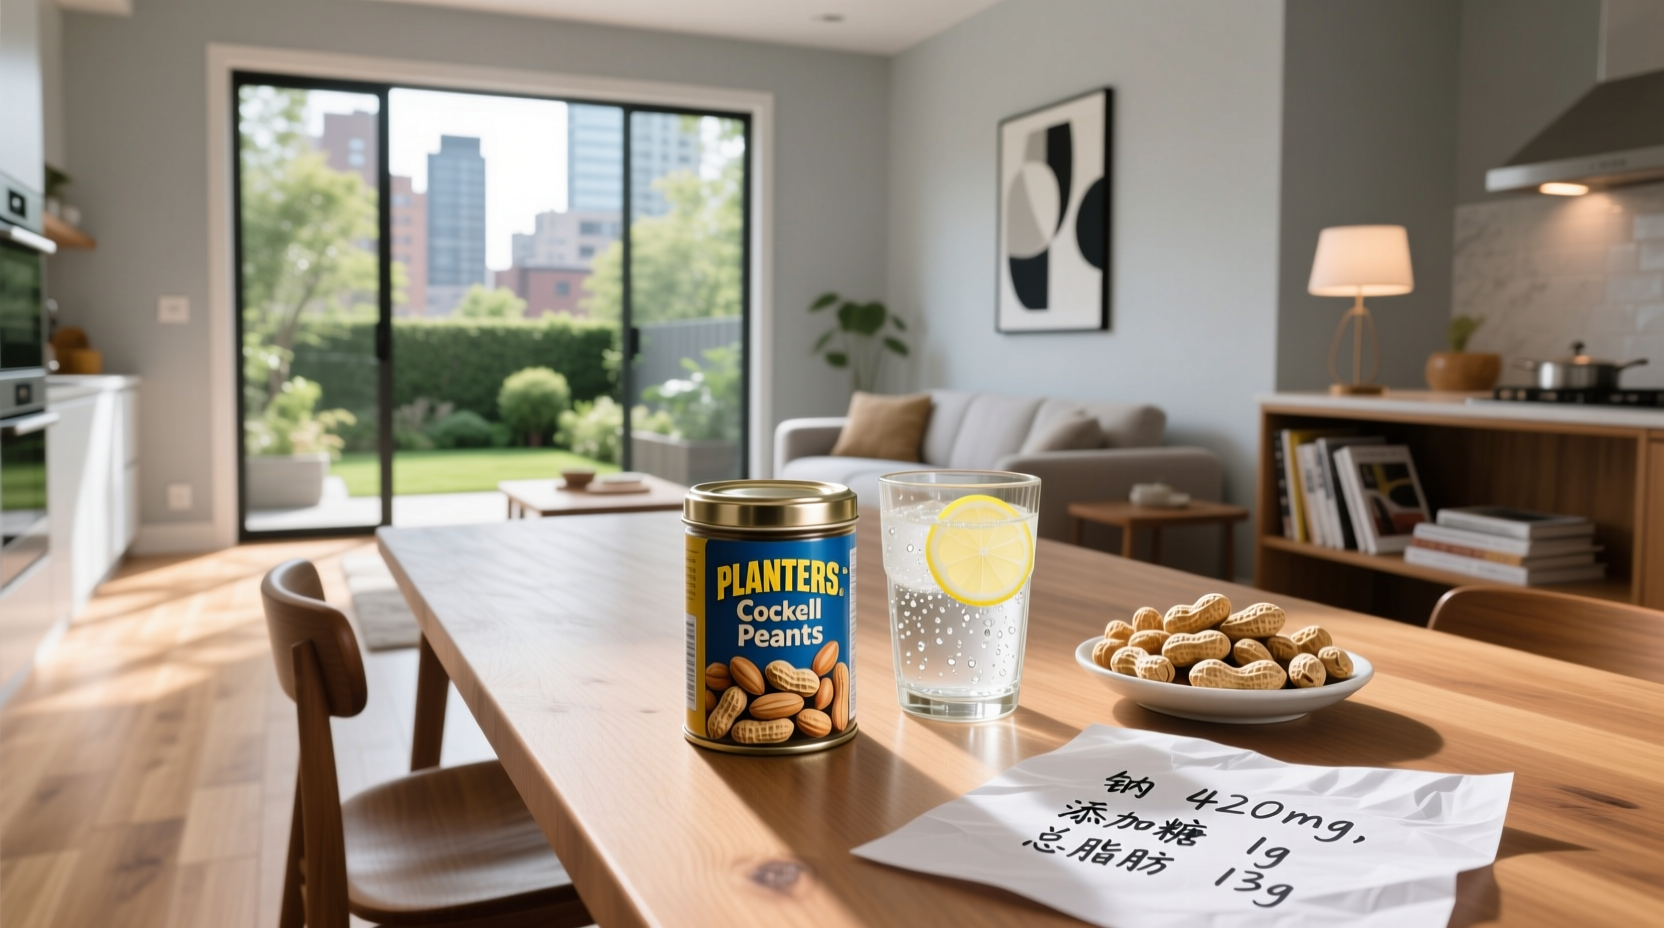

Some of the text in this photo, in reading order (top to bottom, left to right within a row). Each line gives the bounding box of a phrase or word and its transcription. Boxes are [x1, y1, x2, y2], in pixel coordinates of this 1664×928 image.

[736, 597, 822, 622] Cockell
[738, 623, 824, 648] Peants
[1057, 799, 1290, 870] 添加糖 1g
[1104, 770, 1366, 844] 钠 420mg,
[1022, 826, 1294, 908] 总脂肪 13g
